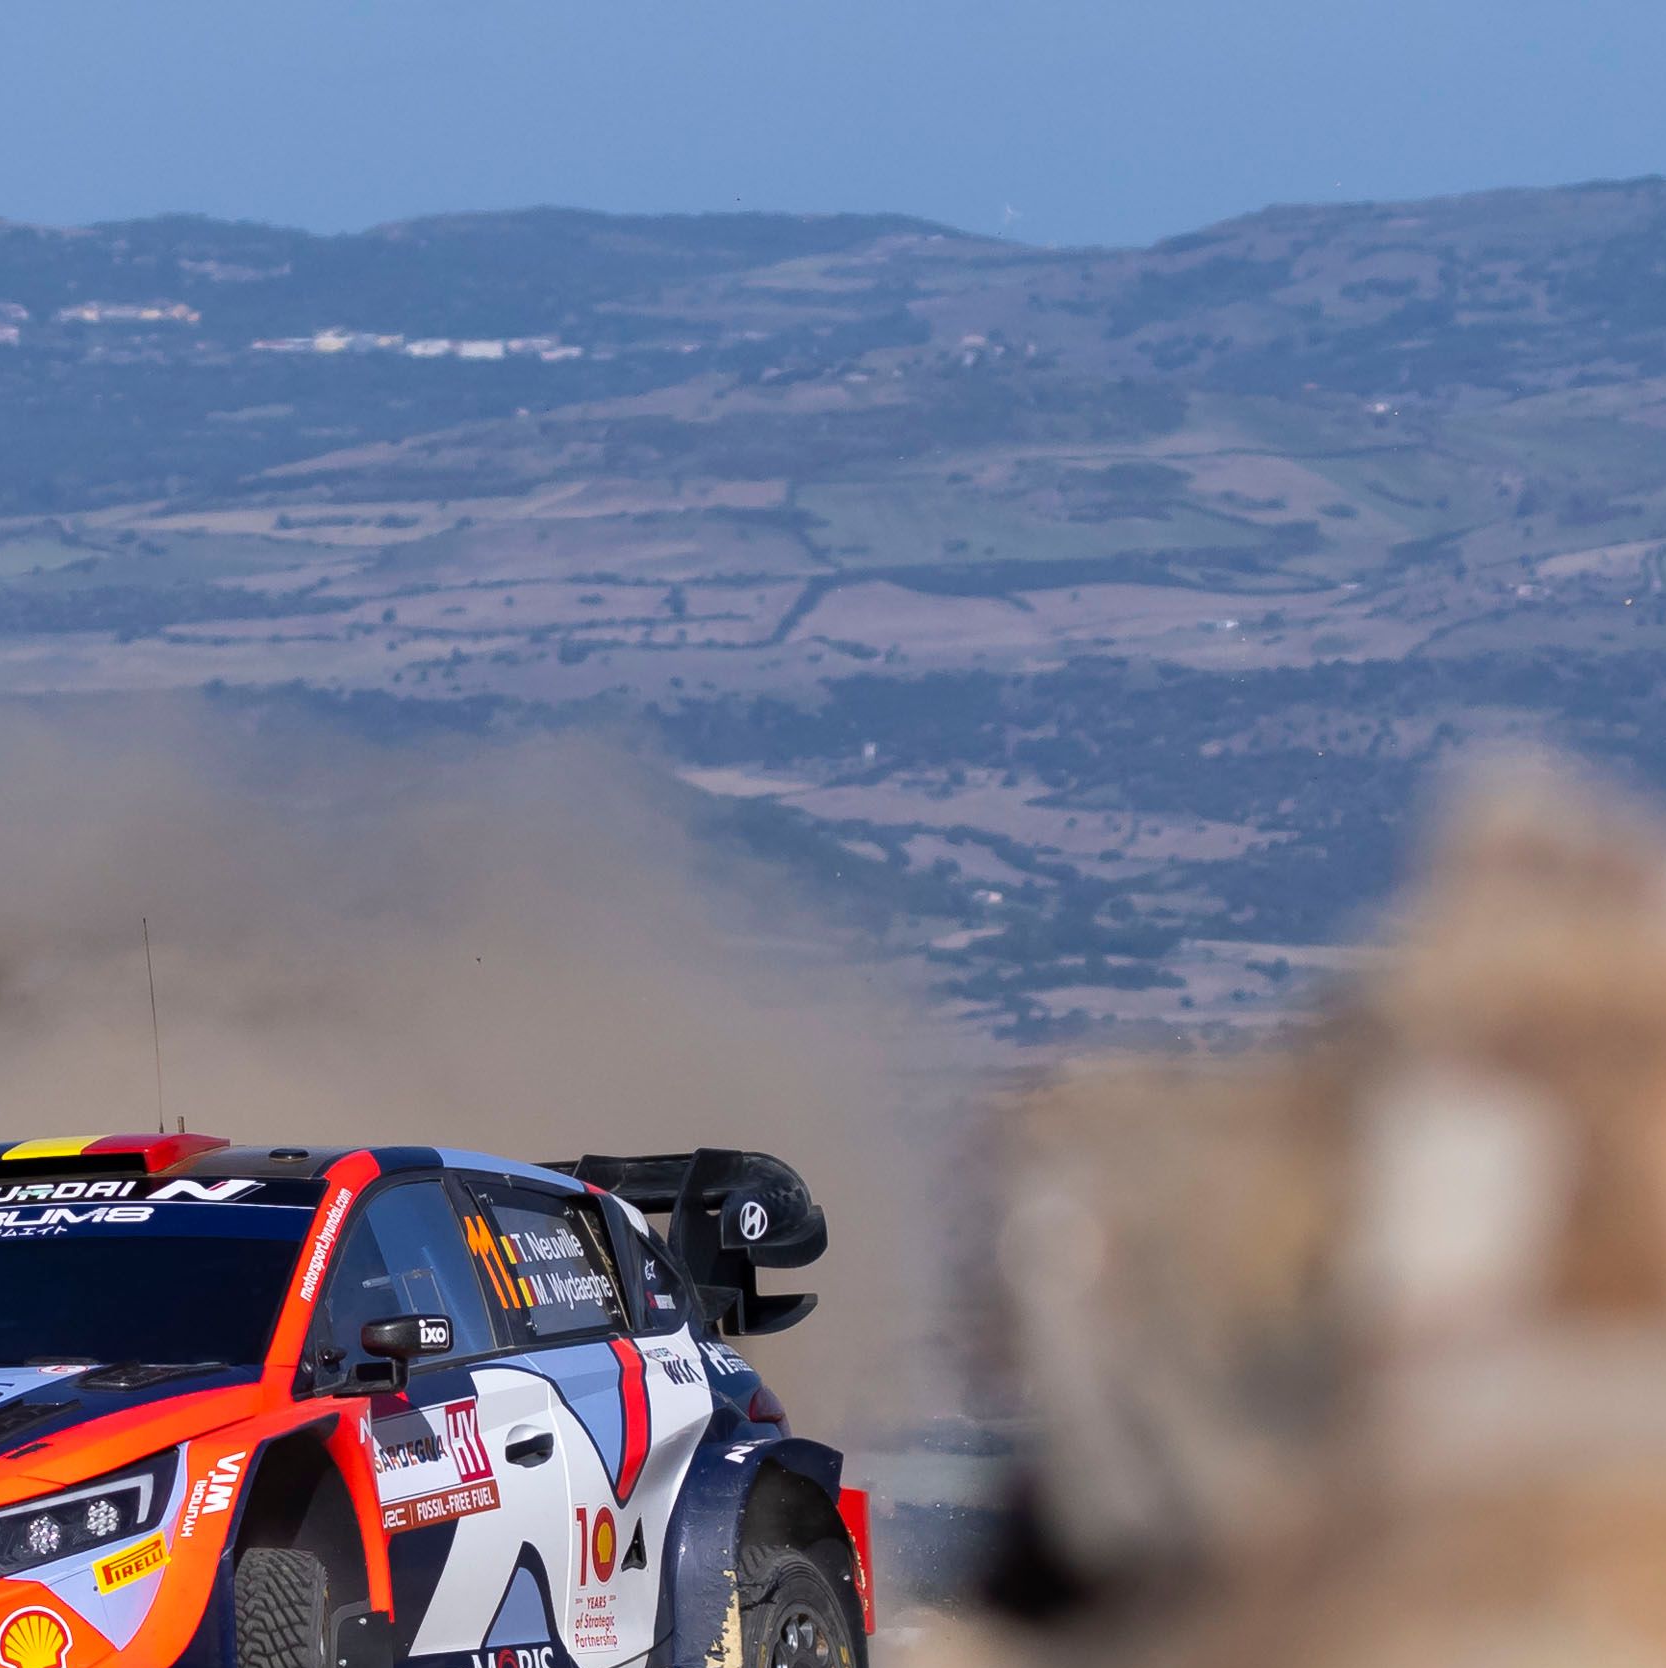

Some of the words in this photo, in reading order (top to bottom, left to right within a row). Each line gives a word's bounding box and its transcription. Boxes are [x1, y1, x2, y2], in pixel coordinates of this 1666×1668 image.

[300, 1187, 353, 1303] motorsport.hyundai.com
[510, 1233, 533, 1263] T.
[524, 1227, 584, 1261] Neuville
[529, 1274, 554, 1306] M.
[546, 1268, 613, 1311] Wydaeghe
[418, 1319, 447, 1344] ixo
[374, 1434, 449, 1474] SARDEGNA
[447, 1408, 486, 1476] HY
[202, 1451, 247, 1514] WIA
[181, 1479, 208, 1538] HYUNDAI
[416, 1490, 472, 1523] FOSSIL-FREE
[471, 1486, 495, 1508] FUEL
[102, 1539, 164, 1586] PIRELLI
[575, 1612, 584, 1629] of
[584, 1611, 615, 1632] Strategic
[587, 1595, 606, 1609] YEARS
[575, 1632, 618, 1648] Partnership
